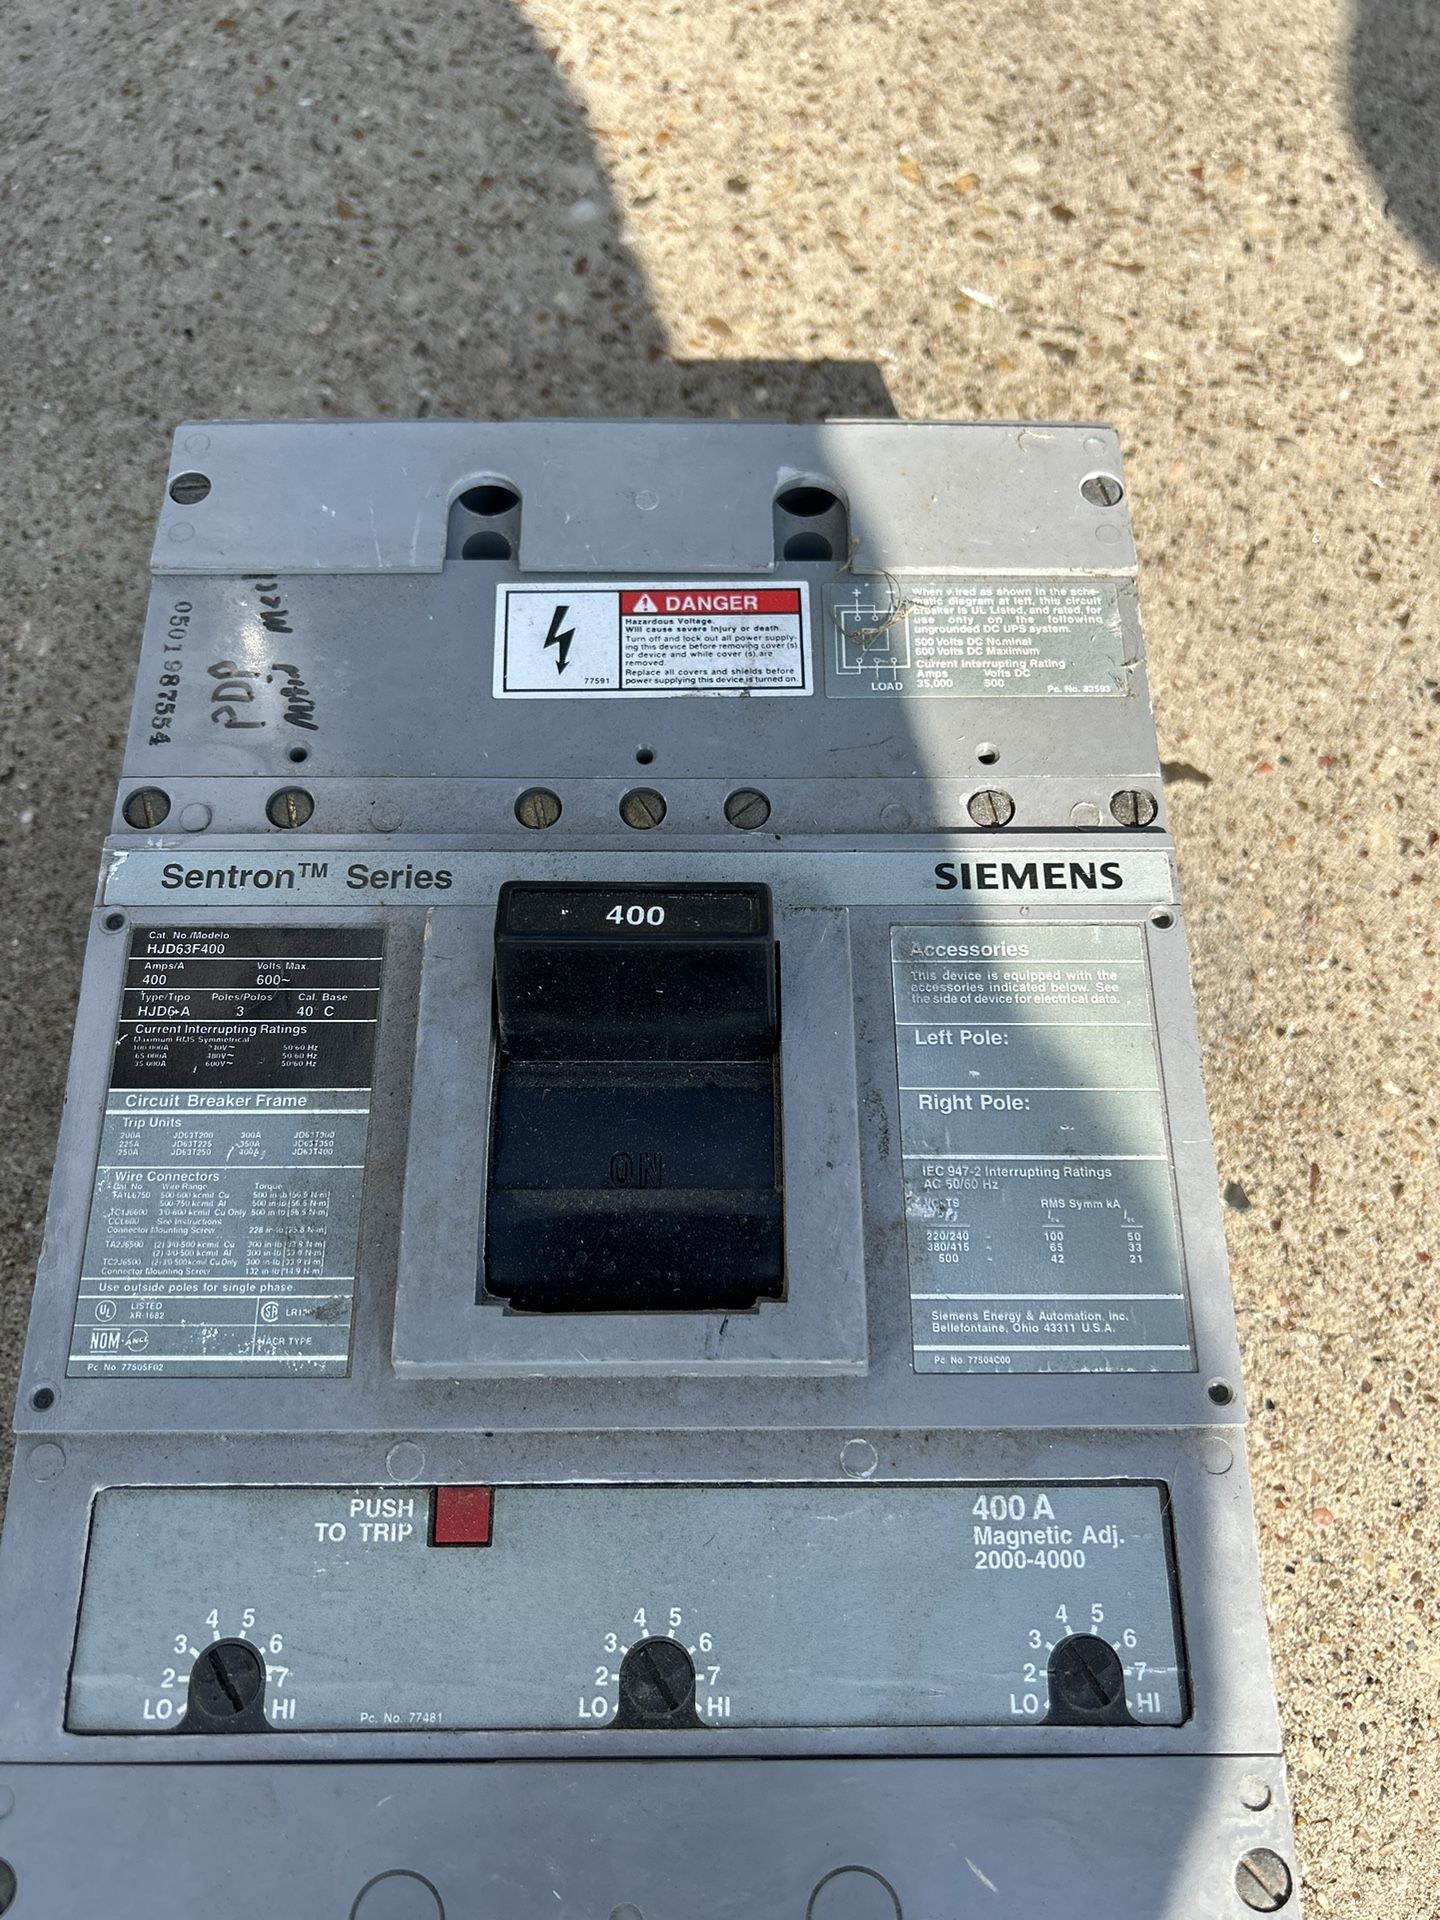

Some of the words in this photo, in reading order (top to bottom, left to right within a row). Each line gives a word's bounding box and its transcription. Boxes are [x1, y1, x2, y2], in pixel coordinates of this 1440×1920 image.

[666, 595, 758, 612] DANGER
[913, 625, 981, 635] ungrounded
[983, 625, 1000, 633] DC
[1003, 625, 1027, 633] UPS
[1029, 625, 1072, 635] system.
[914, 638, 935, 646] 500
[936, 638, 964, 646] Volts
[966, 638, 983, 646] DC
[986, 637, 1032, 646] Nominal
[916, 660, 958, 668] Current
[961, 659, 1026, 670] Interrupting
[1029, 659, 1066, 670] Rating
[625, 669, 661, 677] Replace
[584, 677, 610, 685] 77591
[871, 682, 903, 691] LOAD
[346, 863, 453, 890] Series
[934, 862, 1124, 890] SIEMENS
[605, 905, 666, 927] 400
[147, 943, 225, 955] HJD63F400
[909, 941, 1030, 957] Accessories
[144, 962, 185, 971] Amps/A
[257, 962, 282, 970] Volts
[142, 974, 167, 985] 400
[910, 970, 937, 981] This
[942, 970, 982, 981] device
[987, 970, 998, 981] is
[1003, 970, 1061, 984] equipped
[1065, 970, 1092, 981] with
[1097, 970, 1117, 981] the
[911, 982, 984, 992] accessories
[989, 982, 1046, 992] indicated
[1051, 982, 1090, 992] below.
[1095, 982, 1119, 992] See
[211, 992, 273, 1002] Poles/Polos
[298, 992, 318, 1001] Cal.
[322, 992, 348, 1001] Base
[236, 1006, 244, 1017] 3
[135, 1024, 181, 1034] Current
[184, 1024, 257, 1037] Interrupting
[260, 1024, 307, 1036] Ratings
[914, 1029, 953, 1045] Left
[960, 1029, 1009, 1045] Pole:
[125, 1094, 180, 1108] Circuit
[187, 1094, 252, 1108] Breaker
[256, 1094, 308, 1107] Frame
[918, 1094, 973, 1114] Right
[980, 1094, 1030, 1110] Pole:
[123, 1117, 146, 1130] Trip
[149, 1117, 182, 1128] Units
[115, 1171, 143, 1182] Wire
[147, 1171, 220, 1182] Connectors
[609, 1150, 663, 1188] ON
[922, 1166, 944, 1177] IEC
[948, 1166, 981, 1177] 947-2
[985, 1167, 1060, 1180] Interrupting
[1063, 1167, 1112, 1180] Ratings
[923, 1179, 941, 1189] AC
[946, 1179, 978, 1190] 50/60
[983, 1179, 999, 1190] Hz
[1041, 1199, 1066, 1208] RMS
[1068, 1199, 1103, 1210] Symm
[1106, 1199, 1121, 1208] kA
[926, 1232, 969, 1241] 220/240
[1044, 1232, 1064, 1241] 100
[1127, 1232, 1141, 1241] 50
[927, 1242, 970, 1252] 380/415
[1049, 1243, 1063, 1252] 65
[1128, 1243, 1142, 1252] 33
[938, 1254, 959, 1263] 500
[1051, 1254, 1065, 1263] 42
[1129, 1254, 1143, 1263] 21
[99, 1283, 120, 1292] Use
[123, 1283, 165, 1292] outside
[168, 1283, 199, 1293] poles
[203, 1283, 219, 1291] for
[222, 1283, 256, 1293] single
[131, 1302, 163, 1310] LISTED
[129, 1311, 165, 1320] XR-1682
[931, 1311, 979, 1321] Siemens
[983, 1311, 1022, 1323] Energy
[1026, 1311, 1034, 1321] &
[1108, 1311, 1129, 1321] Inc.
[1014, 1323, 1039, 1333] Ohio
[1044, 1323, 1076, 1333] 43311
[1082, 1323, 1116, 1333] U.S.A.
[90, 1333, 120, 1349] NOM
[968, 1356, 1011, 1365] 77504C00
[350, 1499, 415, 1518] PUSH
[972, 1494, 1026, 1521] 400
[1033, 1493, 1055, 1520] A
[315, 1523, 346, 1541] TO
[359, 1523, 413, 1542] TRIP
[973, 1525, 1073, 1550] Magnetic
[1082, 1524, 1125, 1549] Adj.
[974, 1549, 1086, 1569] 2000-4000
[205, 1609, 219, 1628] 4
[242, 1608, 256, 1628] 5
[633, 1607, 647, 1627] 4
[669, 1607, 681, 1626] 5
[1055, 1604, 1068, 1623] 4
[1091, 1603, 1104, 1622] 5
[173, 1634, 188, 1654] 3
[269, 1634, 283, 1653] 6
[604, 1632, 617, 1652] 3
[699, 1632, 712, 1652] 6
[1028, 1629, 1042, 1649] 3
[1123, 1629, 1137, 1648] 6
[160, 1669, 174, 1688] 2
[275, 1668, 289, 1687] 7
[595, 1666, 608, 1686] 2
[707, 1665, 721, 1685] 7
[1023, 1663, 1037, 1682] 2
[1134, 1662, 1147, 1681] 7
[272, 1699, 296, 1719] HI
[578, 1696, 608, 1717] LO
[707, 1696, 731, 1716] HI
[1010, 1694, 1039, 1714] LO
[1136, 1692, 1161, 1712] HI
[143, 1700, 172, 1720] LO
[360, 1712, 379, 1723] Pc.
[409, 1712, 443, 1723] 77481
